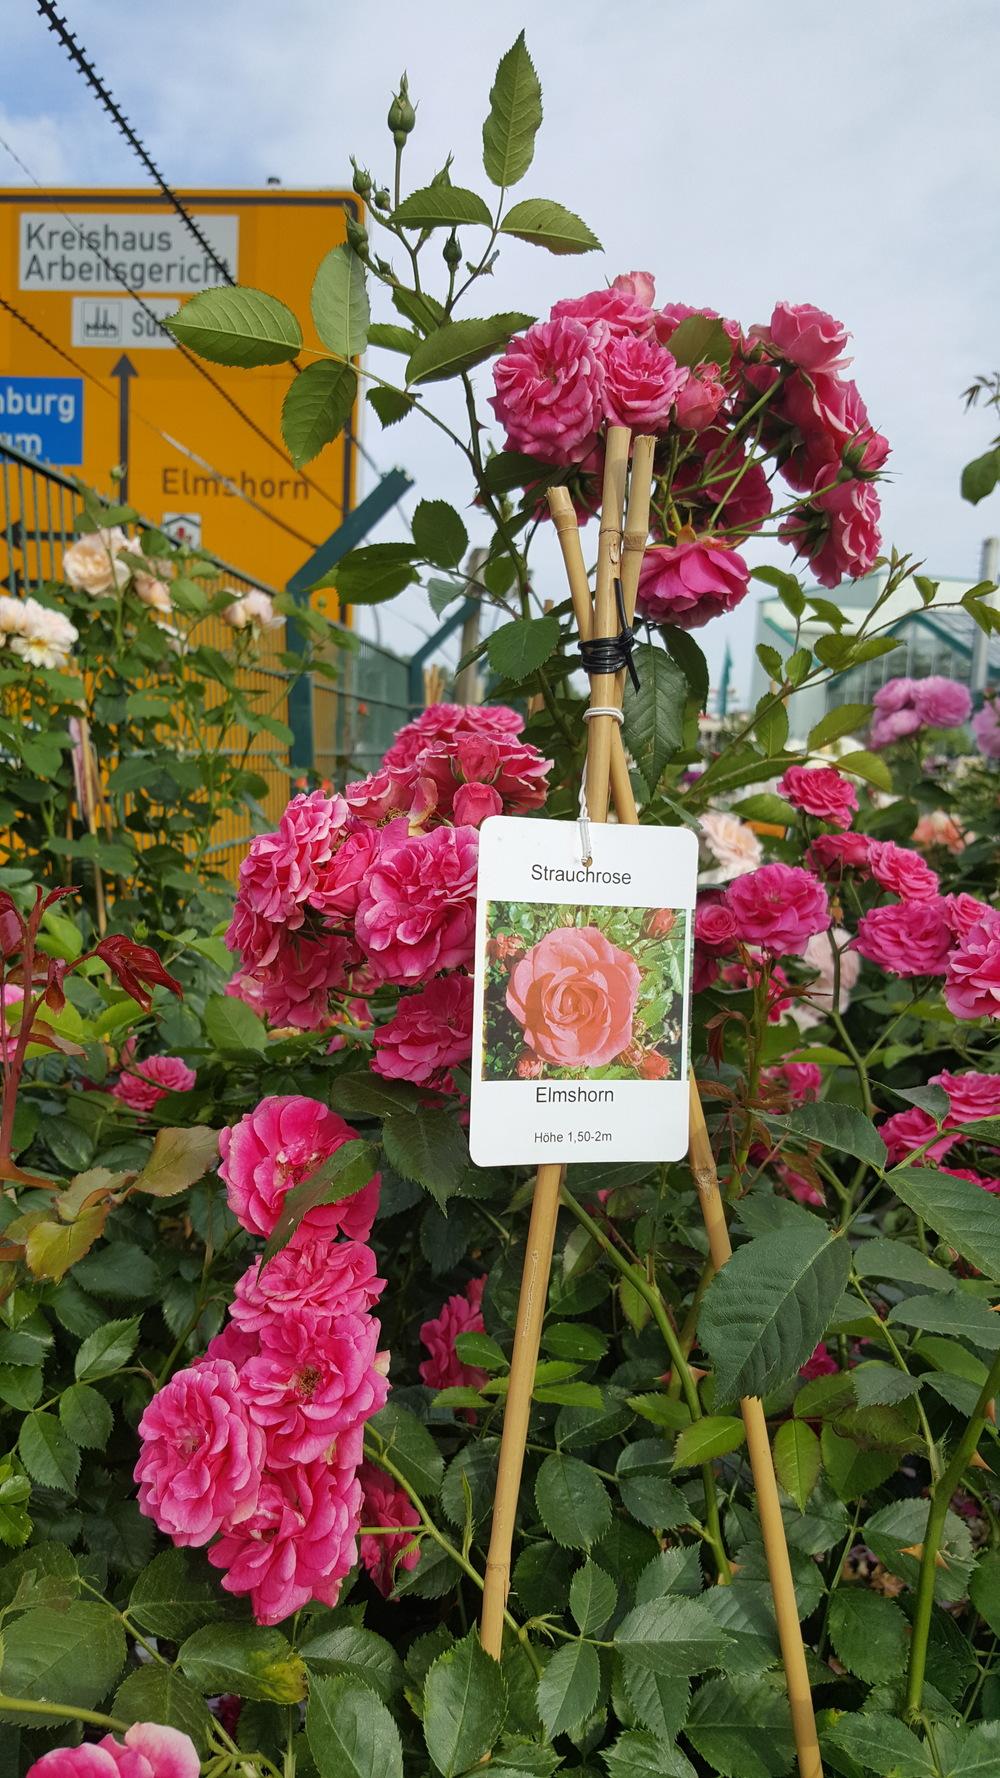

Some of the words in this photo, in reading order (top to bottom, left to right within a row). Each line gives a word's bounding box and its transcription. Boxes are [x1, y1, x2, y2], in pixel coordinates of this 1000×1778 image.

[26, 223, 172, 251] Kreishaus
[162, 468, 310, 500] Elmshorn
[531, 864, 632, 885] Strauchrose
[536, 1086, 615, 1103] Elmshorn
[534, 1132, 564, 1143] Höhe
[568, 1131, 613, 1144] 1,50-2m
